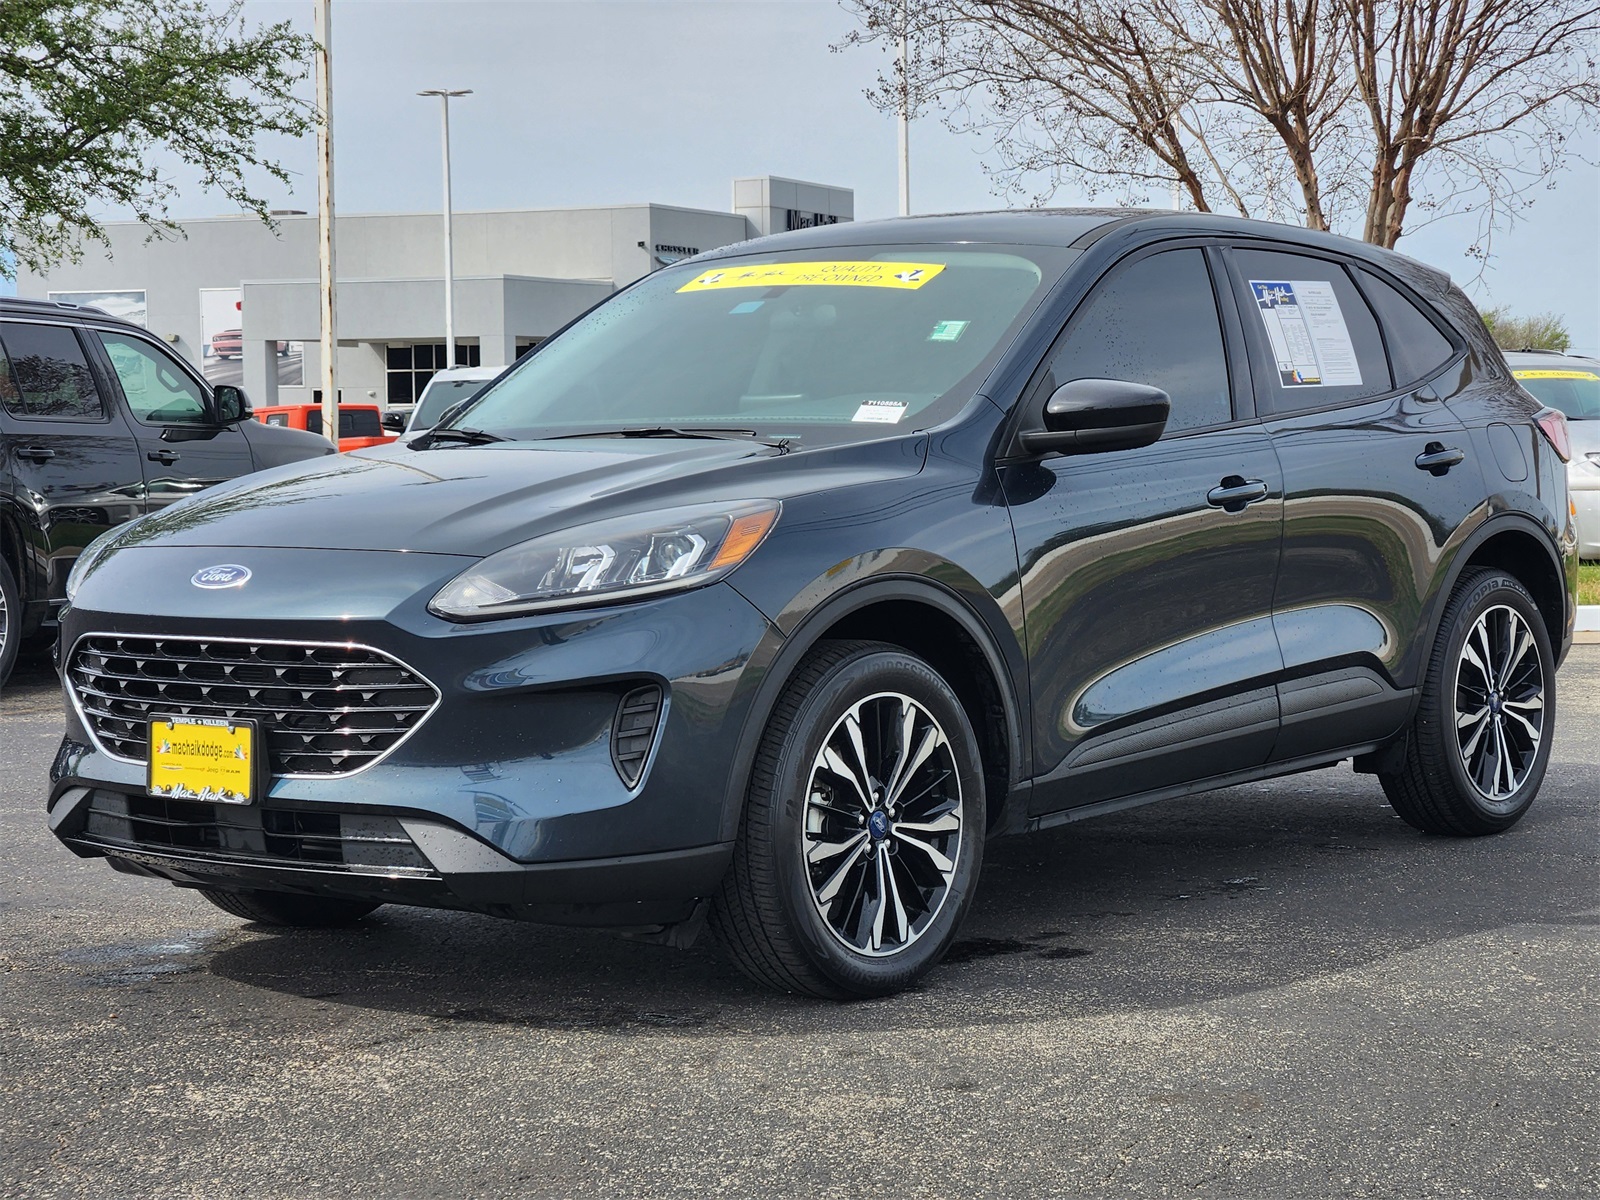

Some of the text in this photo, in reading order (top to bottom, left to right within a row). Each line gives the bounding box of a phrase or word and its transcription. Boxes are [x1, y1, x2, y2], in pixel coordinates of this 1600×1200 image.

[821, 265, 887, 273] QUALITY
[201, 567, 238, 582] Ford
[862, 660, 947, 693] BRIDGESTONE
[171, 716, 229, 727] TEMPLE KILLEEN
[171, 740, 233, 761] machaikdodge.com
[171, 783, 227, 801] Mac Haik
